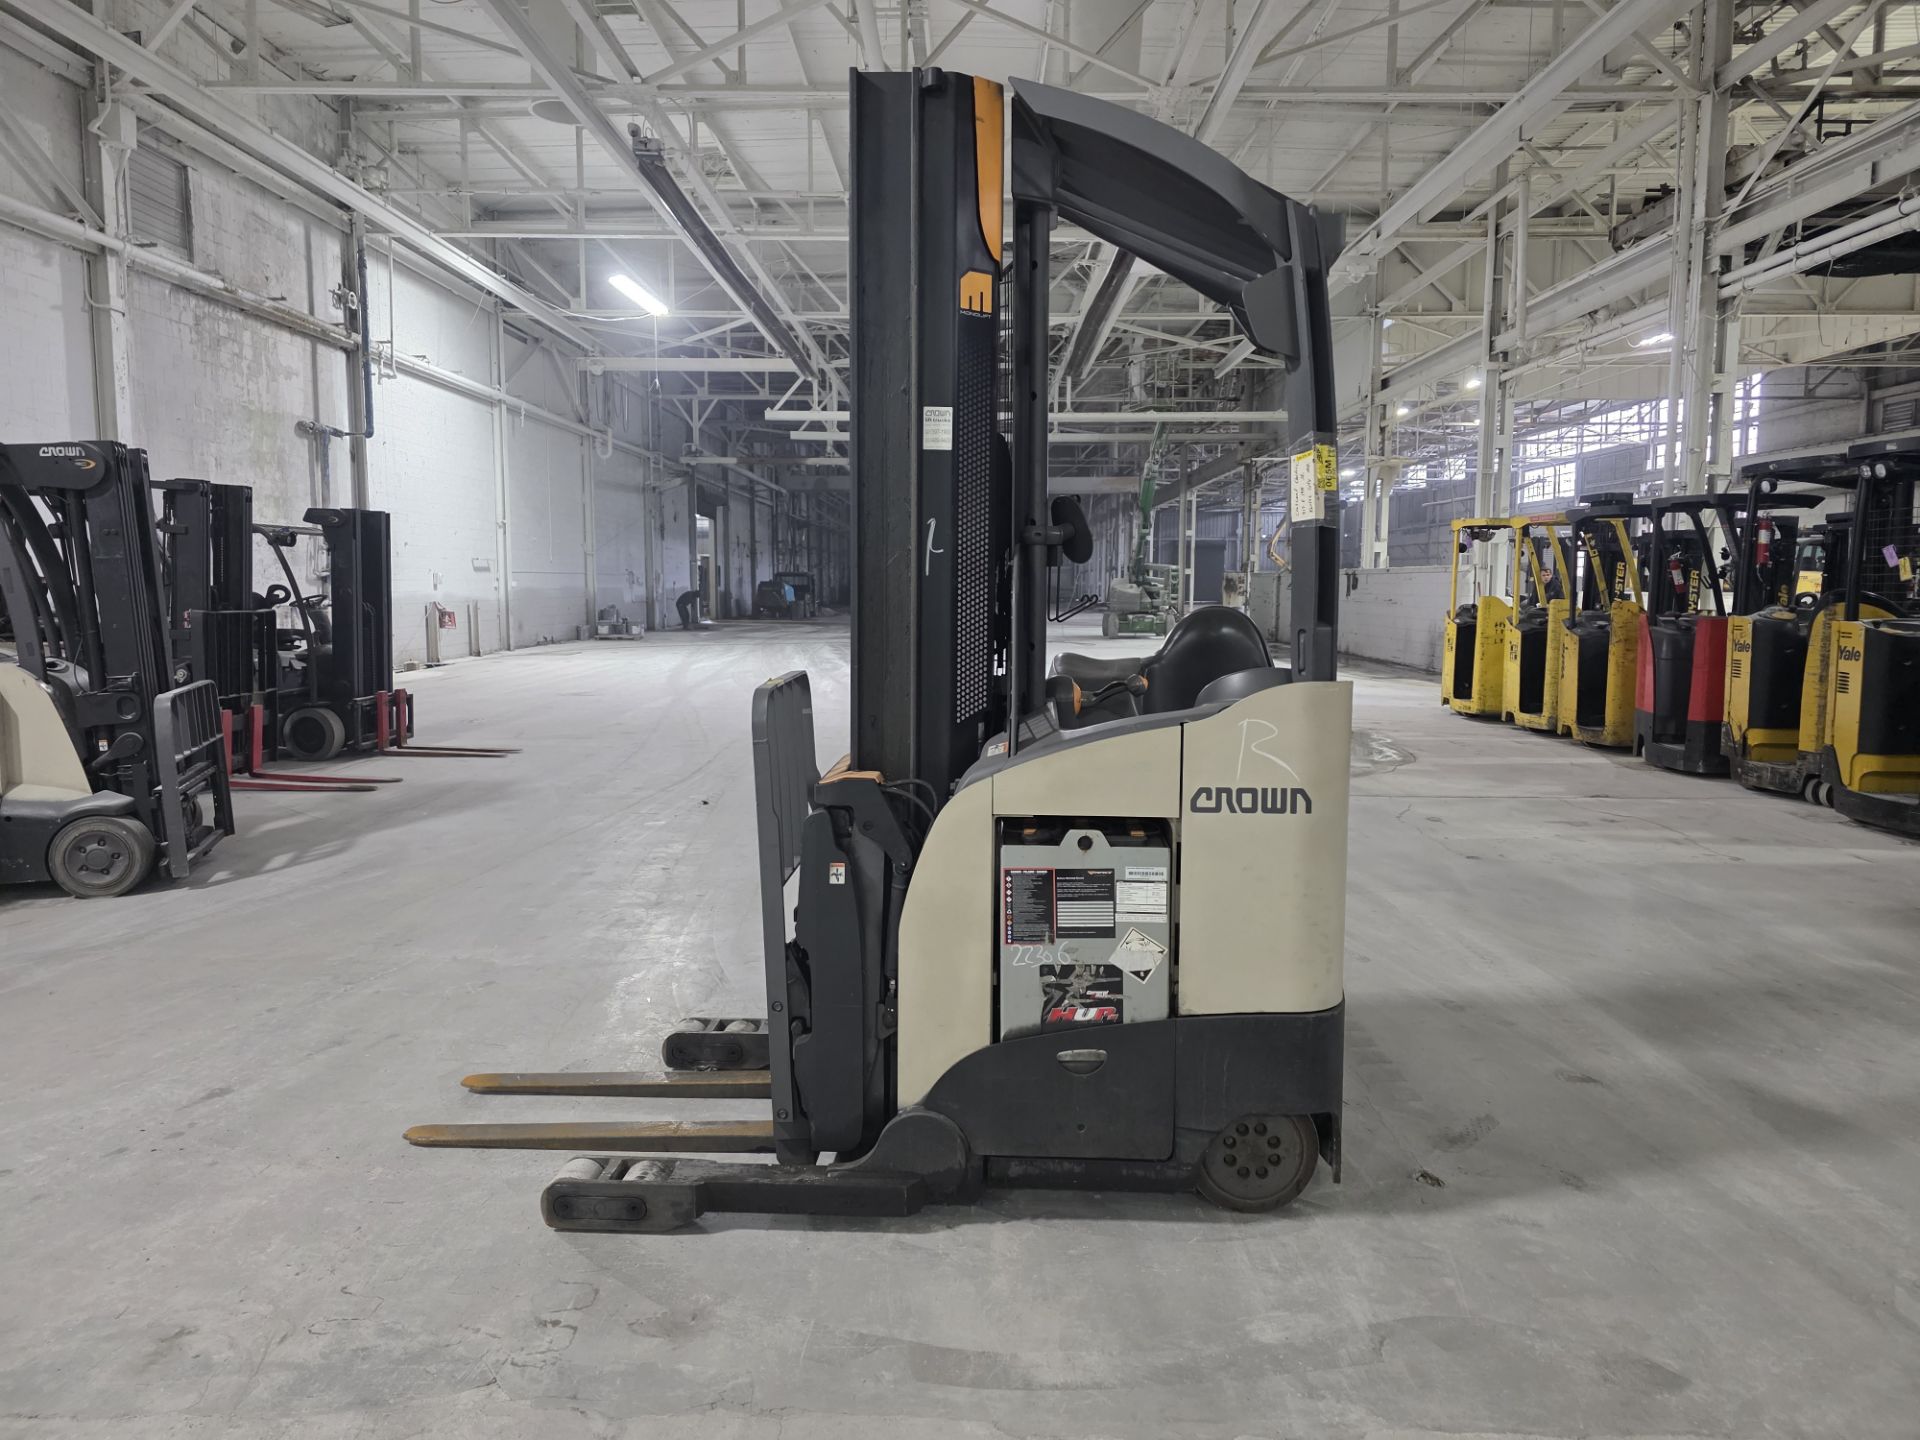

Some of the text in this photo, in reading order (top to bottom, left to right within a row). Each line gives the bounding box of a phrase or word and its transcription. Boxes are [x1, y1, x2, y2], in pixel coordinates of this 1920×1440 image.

[39, 446, 86, 457] CROWN
[1778, 584, 1788, 606] ale
[1734, 639, 1750, 653] Yale
[1839, 645, 1861, 662] Yale
[1237, 718, 1300, 782] R
[1190, 787, 1312, 814] CROWN
